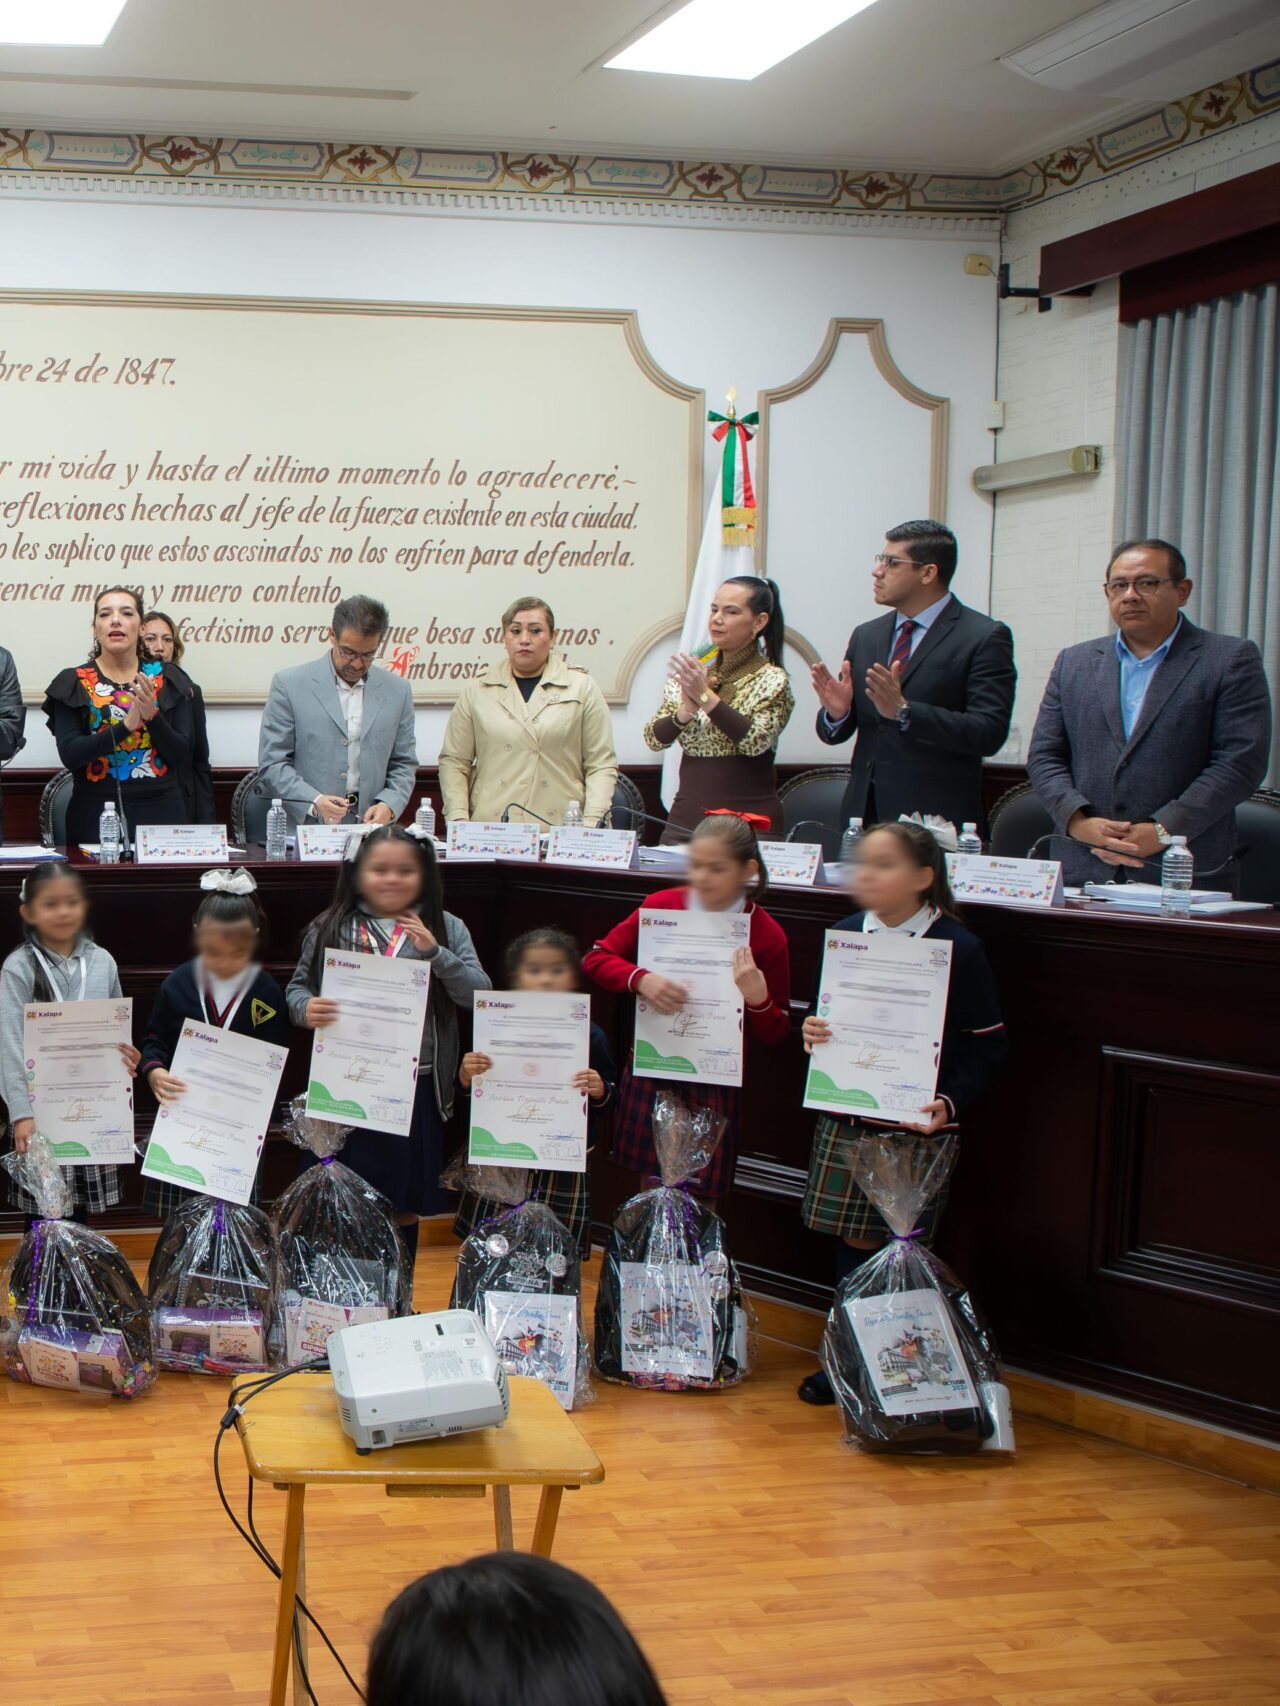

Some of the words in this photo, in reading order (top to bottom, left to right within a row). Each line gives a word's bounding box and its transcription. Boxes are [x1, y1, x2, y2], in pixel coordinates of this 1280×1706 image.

[36, 357, 71, 383] 24
[74, 353, 108, 383] de
[113, 358, 176, 385] 1847.
[19, 455, 55, 479] mi
[59, 449, 116, 480] vida
[119, 464, 139, 490] y
[146, 451, 219, 481] hasta
[225, 454, 252, 481] el
[338, 458, 440, 485] momento
[448, 459, 467, 486] lo
[131, 493, 217, 521] hechas
[220, 493, 249, 522] al
[243, 497, 295, 530] jefe
[298, 495, 326, 523] de
[329, 496, 351, 524] la
[343, 496, 419, 531] fuerza
[423, 498, 502, 526] existente
[505, 511, 527, 527] en
[530, 501, 569, 528] esta
[572, 502, 639, 529] ciudad.
[12, 532, 40, 560] les
[45, 533, 115, 568] suplico
[121, 544, 153, 569] que
[158, 536, 209, 562] estos
[213, 535, 323, 563] asesinatos
[328, 547, 353, 563] no
[358, 536, 388, 564] los
[395, 539, 465, 572] enfríen
[466, 546, 519, 573] para
[524, 540, 634, 574] defenderla.
[148, 584, 164, 610] y
[171, 584, 242, 603] muero
[426, 617, 475, 644] besa
[653, 919, 677, 928] Xalapa
[840, 942, 868, 952] Xalapa
[337, 960, 361, 970] Xalapa
